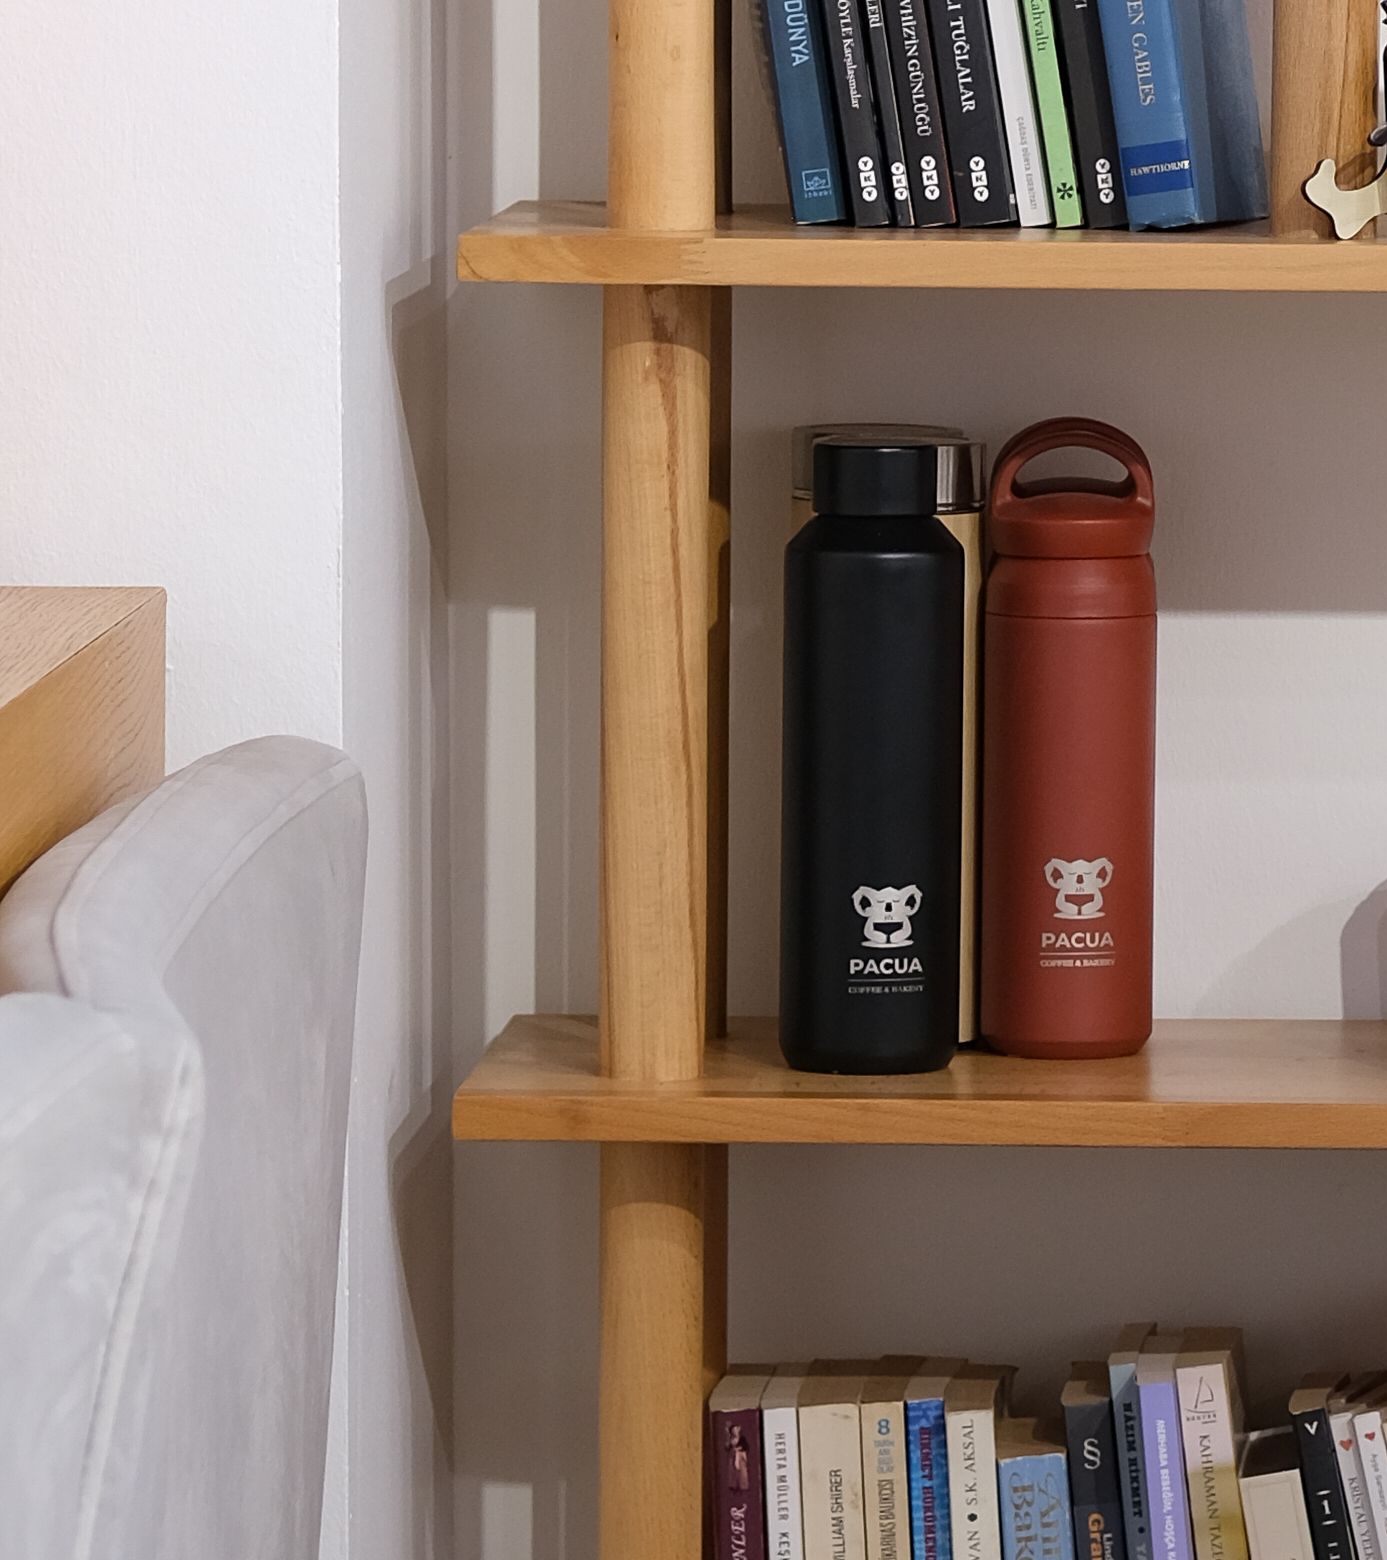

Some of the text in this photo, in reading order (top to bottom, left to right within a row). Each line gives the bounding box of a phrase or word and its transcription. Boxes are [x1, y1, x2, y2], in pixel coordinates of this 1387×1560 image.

[784, 0, 811, 68] DÜNYA
[950, 16, 976, 113] TUĞLALAR
[1131, 31, 1156, 107] GABLES
[1130, 159, 1191, 177] HAWTHORNE
[1041, 931, 1115, 949] PACUA
[849, 957, 924, 975] PACUA
[1040, 959, 1074, 968] COFFEE
[829, 1468, 844, 1514] SHIRER
[1199, 1434, 1220, 1519] KAHRAMAN
